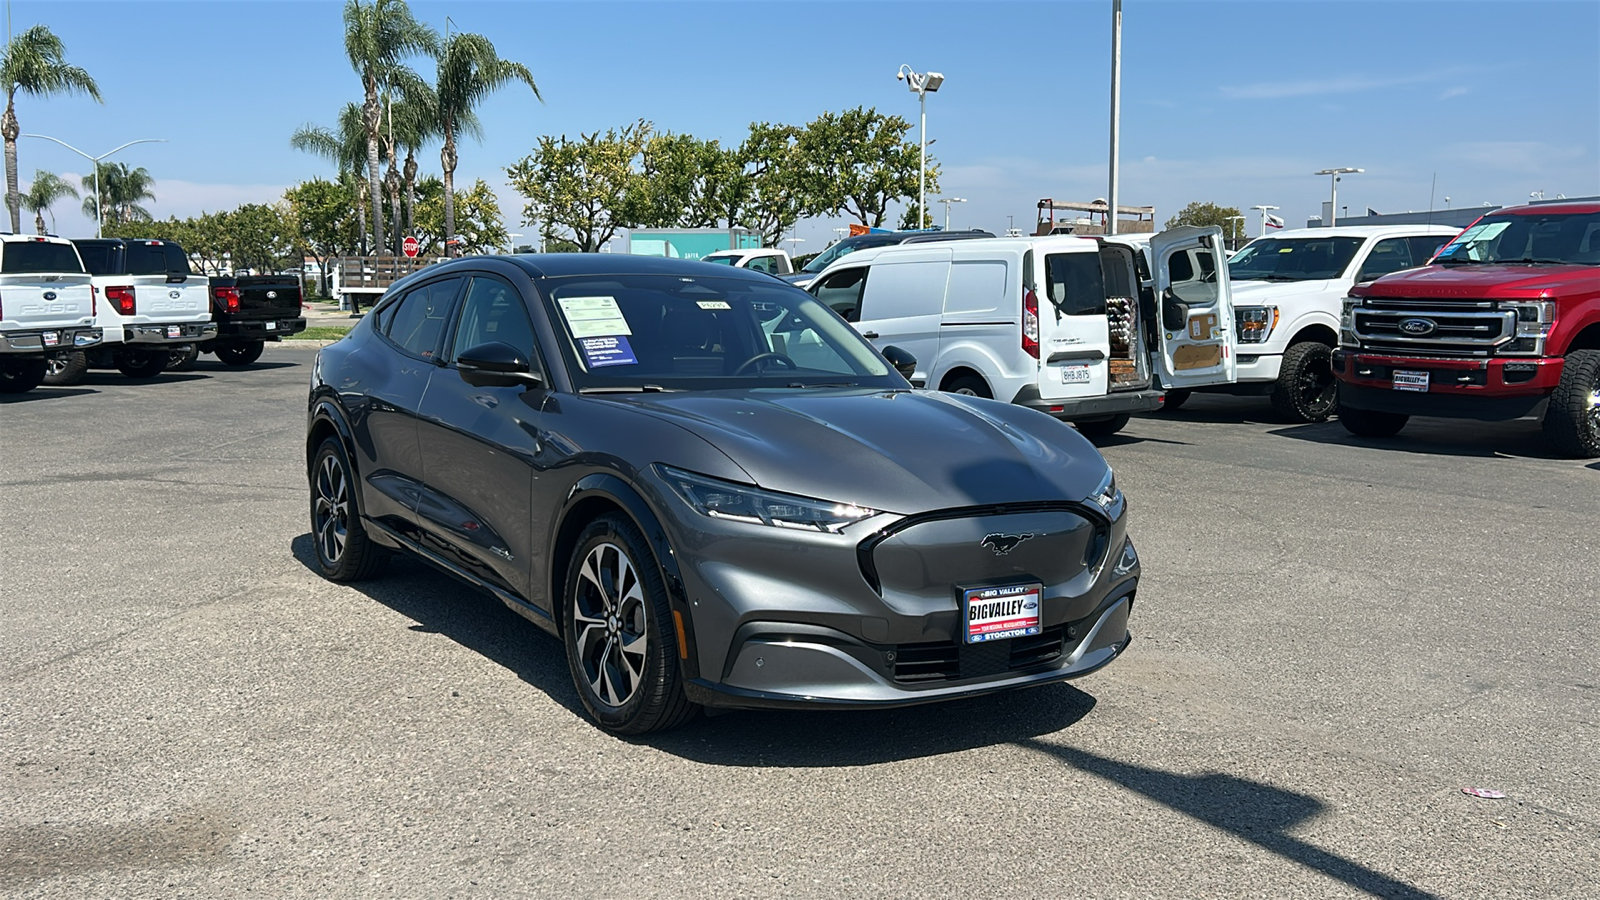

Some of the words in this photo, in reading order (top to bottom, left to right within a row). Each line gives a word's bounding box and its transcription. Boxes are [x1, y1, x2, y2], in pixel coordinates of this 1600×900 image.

[404, 242, 418, 251] STOP
[20, 303, 79, 315] F-150
[151, 302, 198, 310] F-150
[1405, 321, 1426, 332] Ford
[1063, 370, 1090, 380] 8HBJ875
[970, 600, 1024, 620] BIGVALLEY
[985, 628, 1026, 640] STOCKTON
